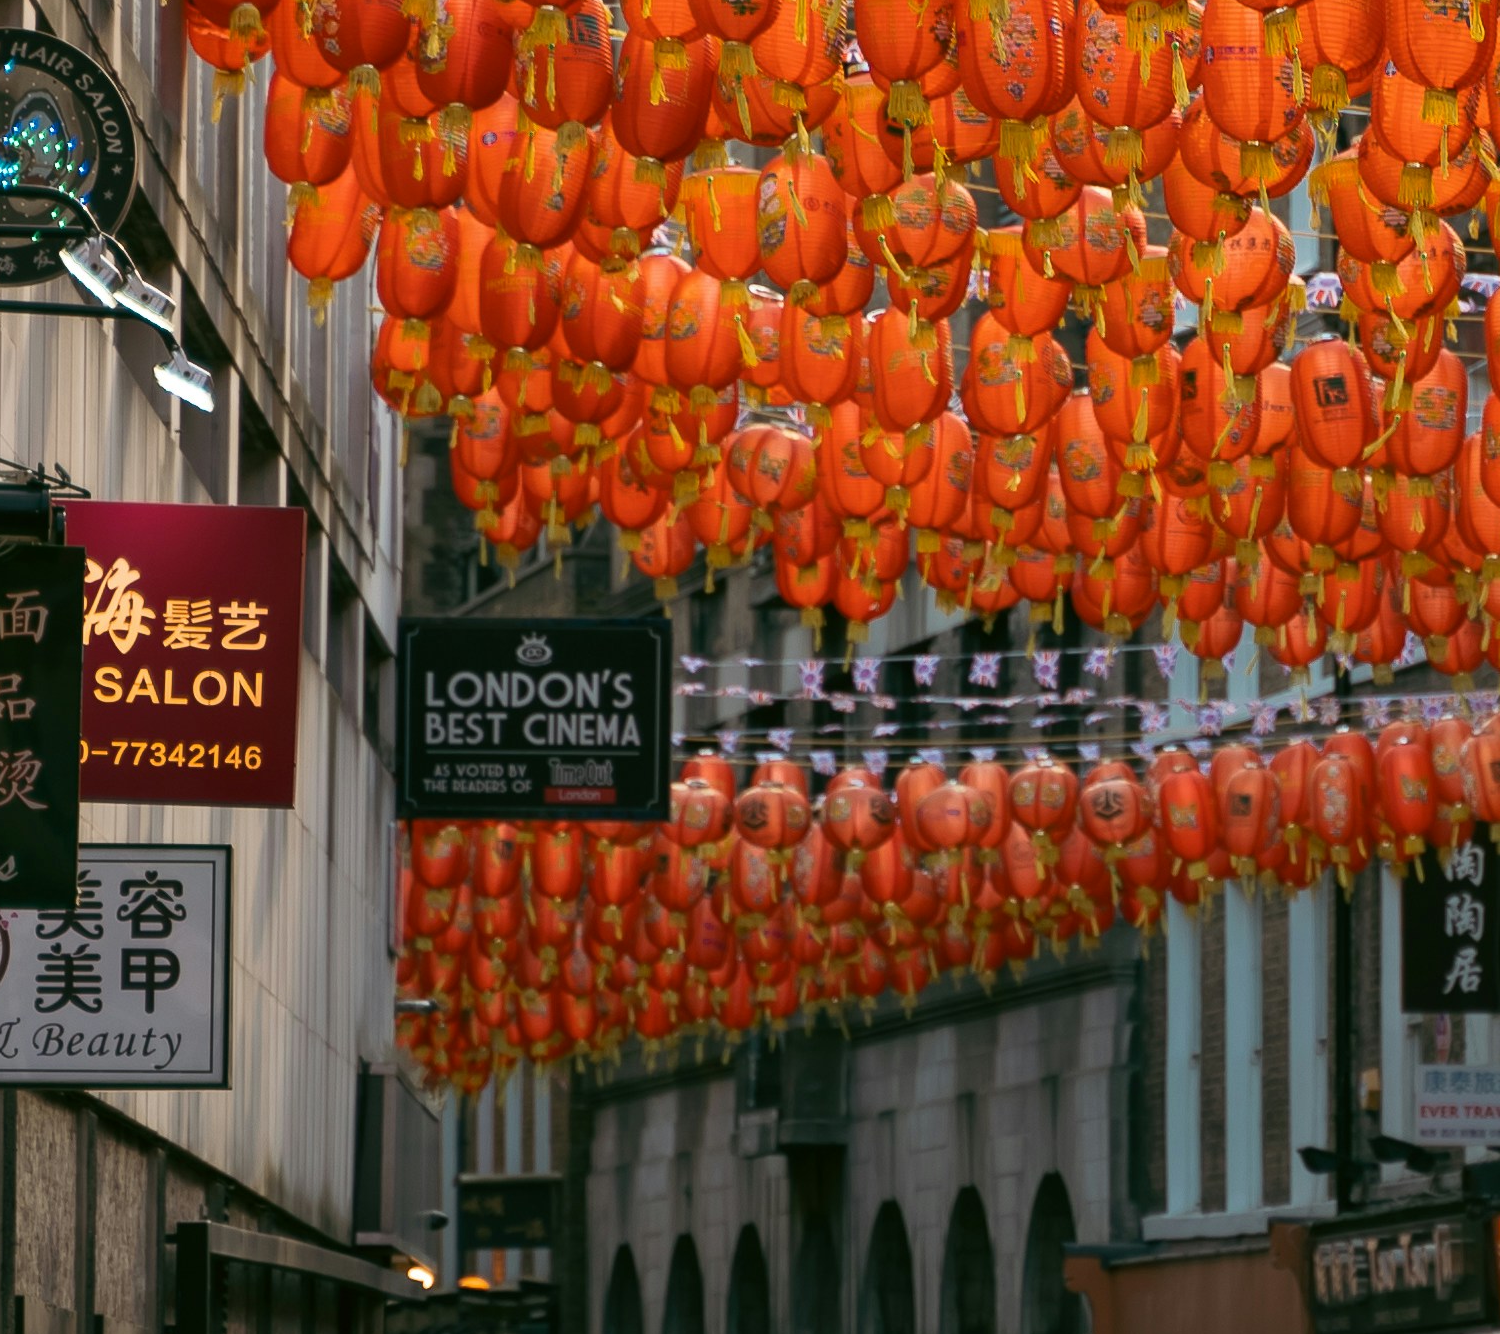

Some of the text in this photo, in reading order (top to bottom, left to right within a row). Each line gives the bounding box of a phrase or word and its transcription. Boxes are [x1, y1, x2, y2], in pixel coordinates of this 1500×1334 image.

[9, 40, 75, 79] HAIR
[74, 71, 125, 156] SALON
[92, 665, 266, 708] SALON
[425, 668, 635, 709] LONDON'S
[424, 711, 642, 747] BEST CINEMA
[422, 779, 533, 794] THE READERS OF
[433, 763, 528, 779] AS VOTED BY
[558, 789, 602, 802] London
[1441, 839, 1486, 996] 陶陶居
[33, 941, 183, 1016] 美甲
[32, 1022, 184, 1070] Beauty
[1420, 1105, 1460, 1119] EVER
